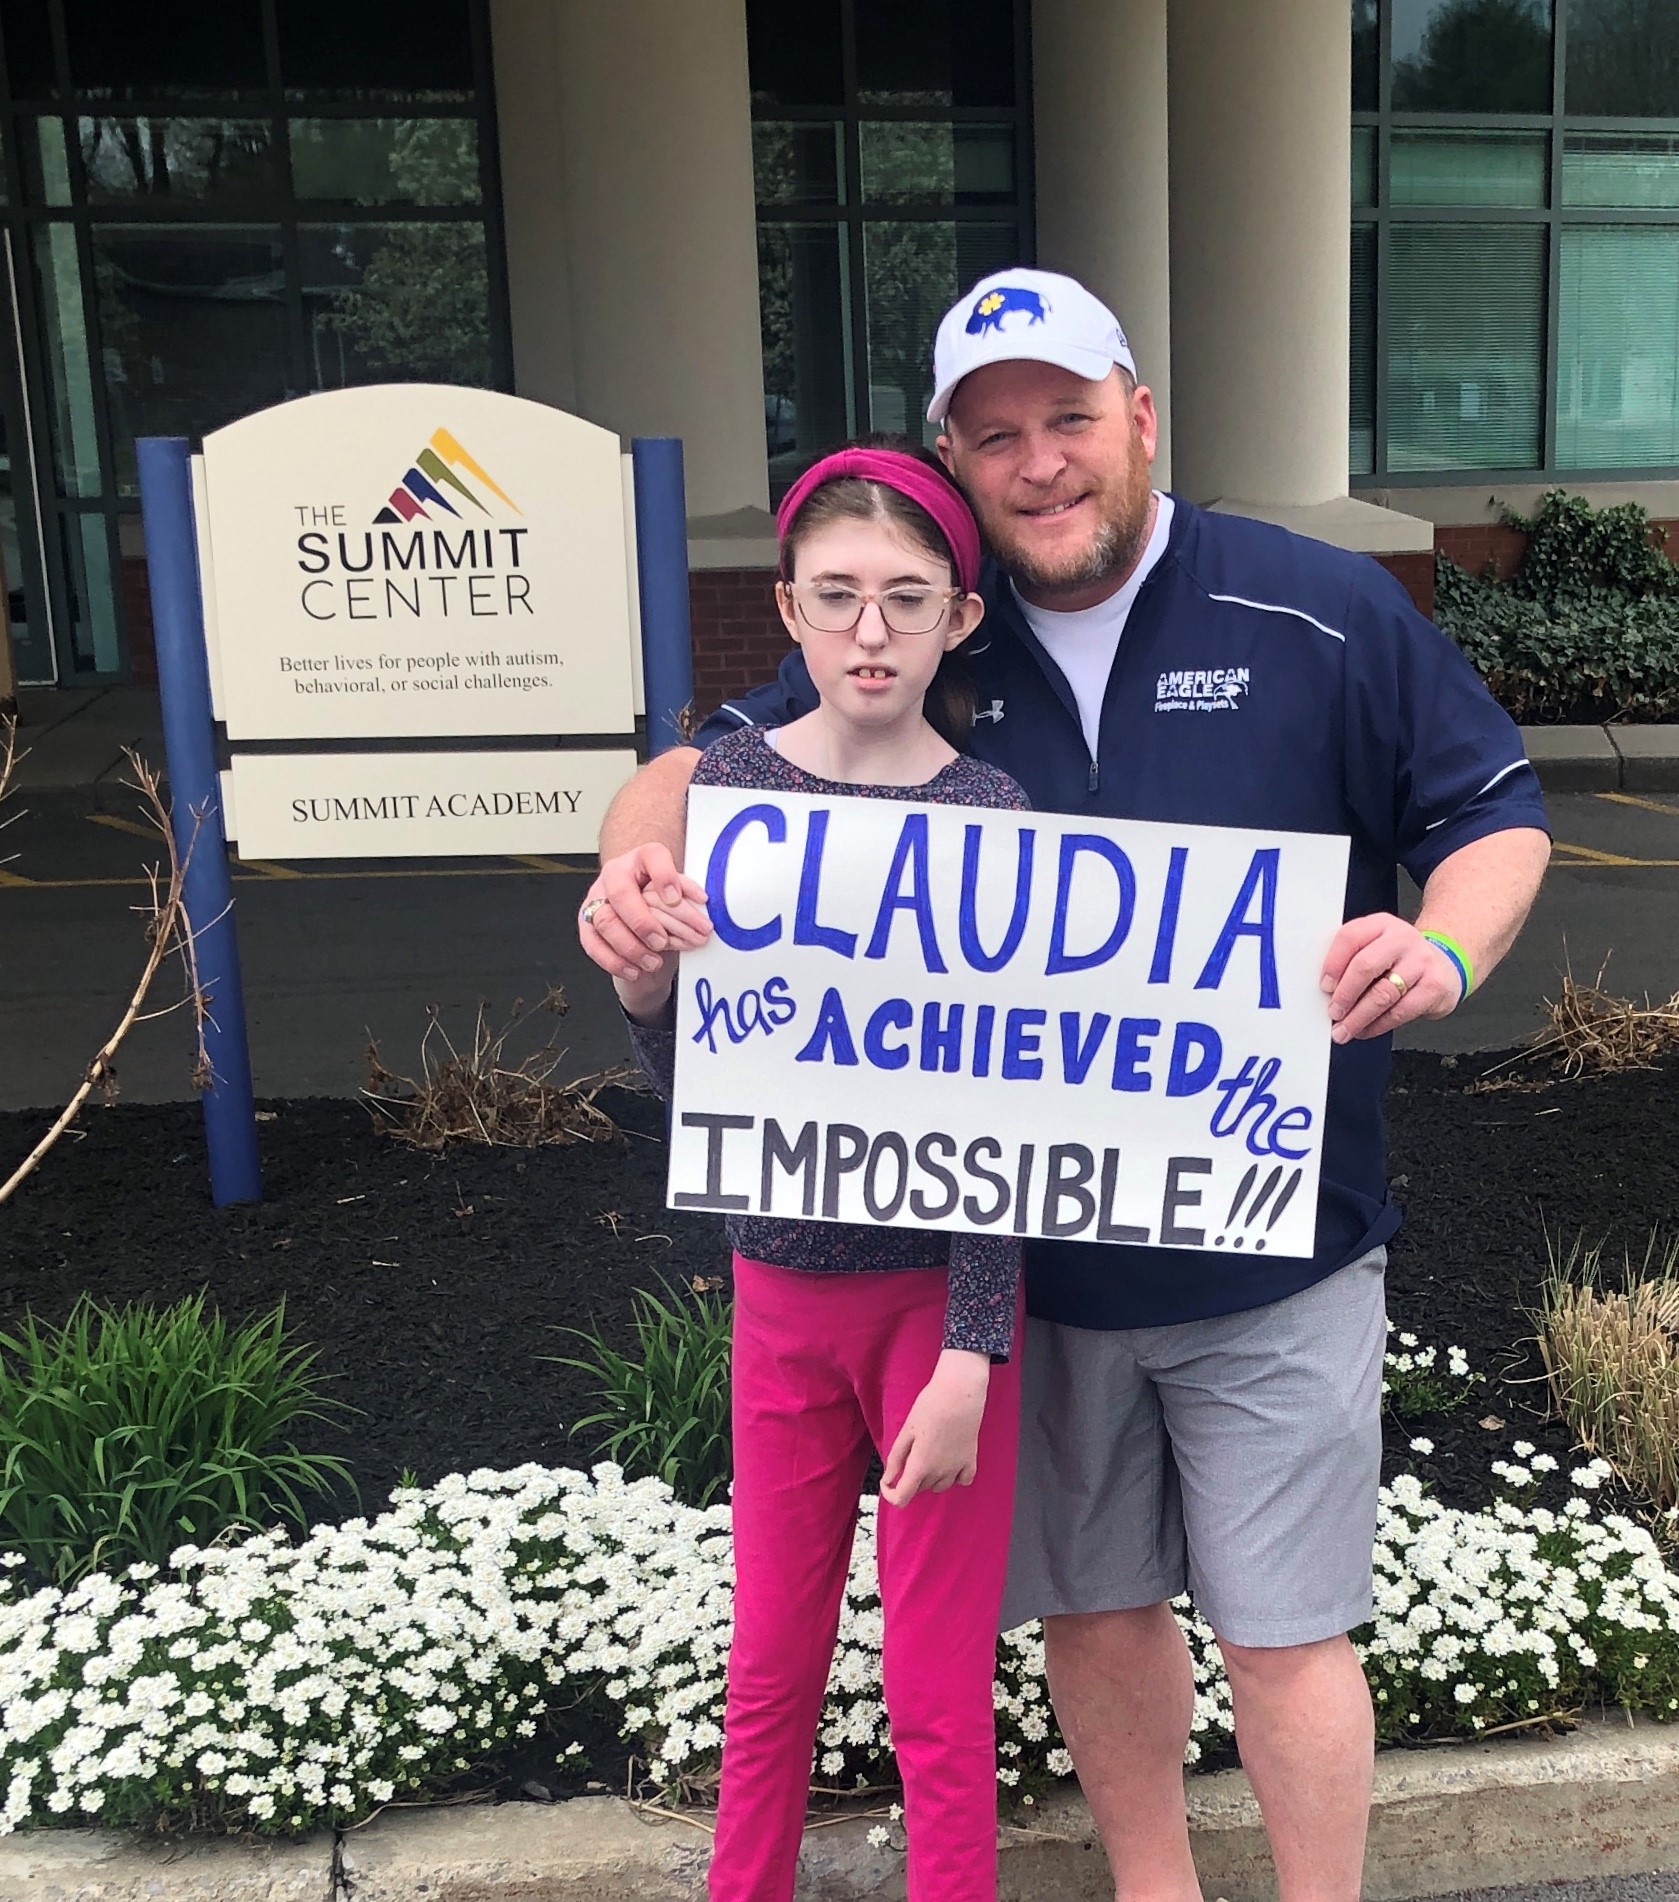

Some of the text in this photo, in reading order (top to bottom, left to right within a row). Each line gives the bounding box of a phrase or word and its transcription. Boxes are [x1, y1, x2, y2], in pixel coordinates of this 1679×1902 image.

[294, 505, 347, 527] THE
[297, 528, 528, 573] SUMMIT
[301, 574, 534, 620] CENTER
[279, 650, 564, 673] Better lives for people with autism,
[294, 672, 554, 694] behavioral, or social challenges.
[1157, 668, 1250, 687] AMERICAN
[1157, 683, 1214, 699] EAGLE
[1188, 700, 1195, 711] &
[292, 790, 583, 823] SUMMIT ACADEMY
[705, 803, 1283, 1009] CLAUDIA
[692, 976, 1313, 1159] has ACHIEVED the
[674, 1111, 1303, 1251] IMPOSSIBLE!!!
